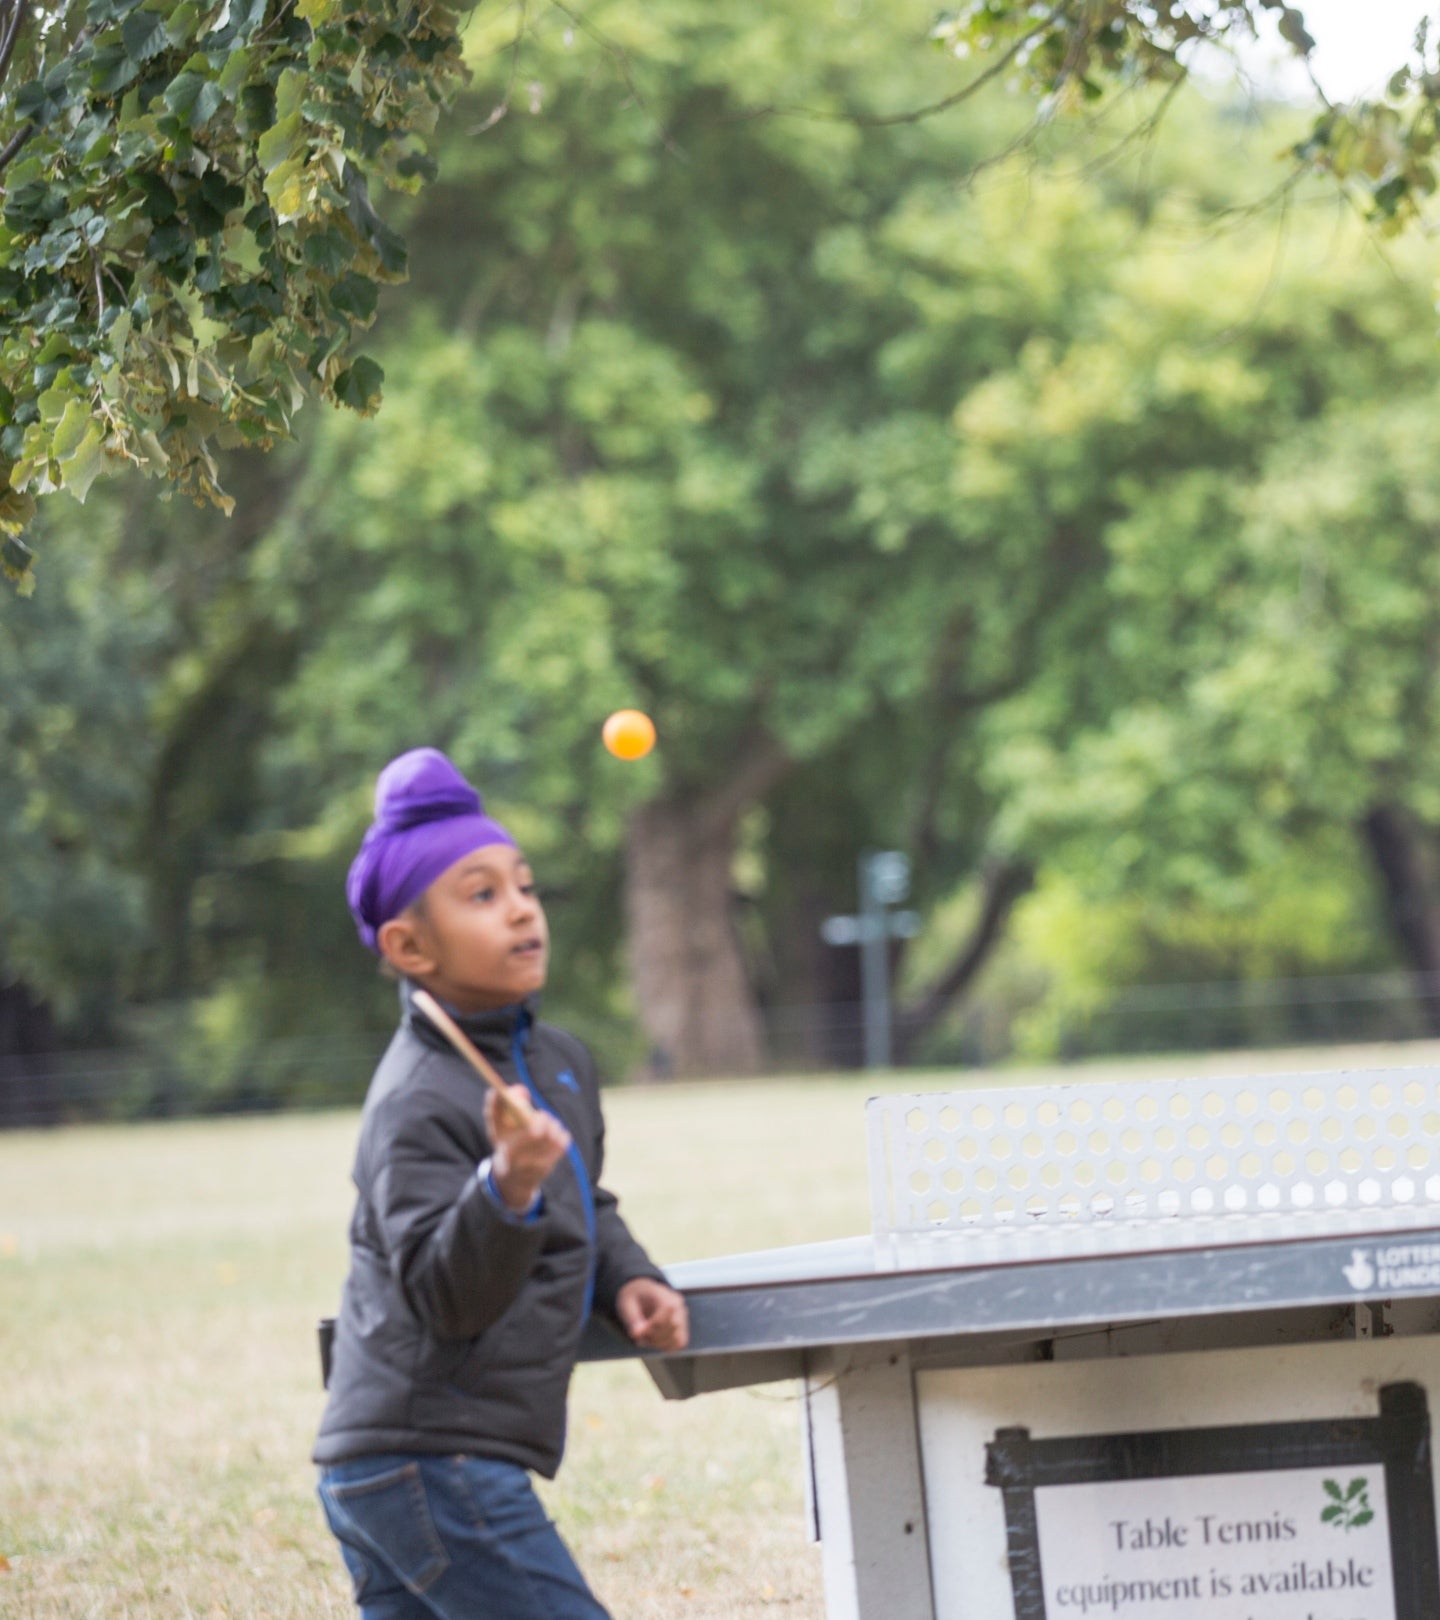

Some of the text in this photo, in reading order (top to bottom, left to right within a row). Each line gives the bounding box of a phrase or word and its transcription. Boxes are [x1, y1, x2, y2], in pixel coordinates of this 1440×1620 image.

[1109, 1511, 1297, 1552] Table Tennis
[1055, 1559, 1375, 1613] equipment is available
